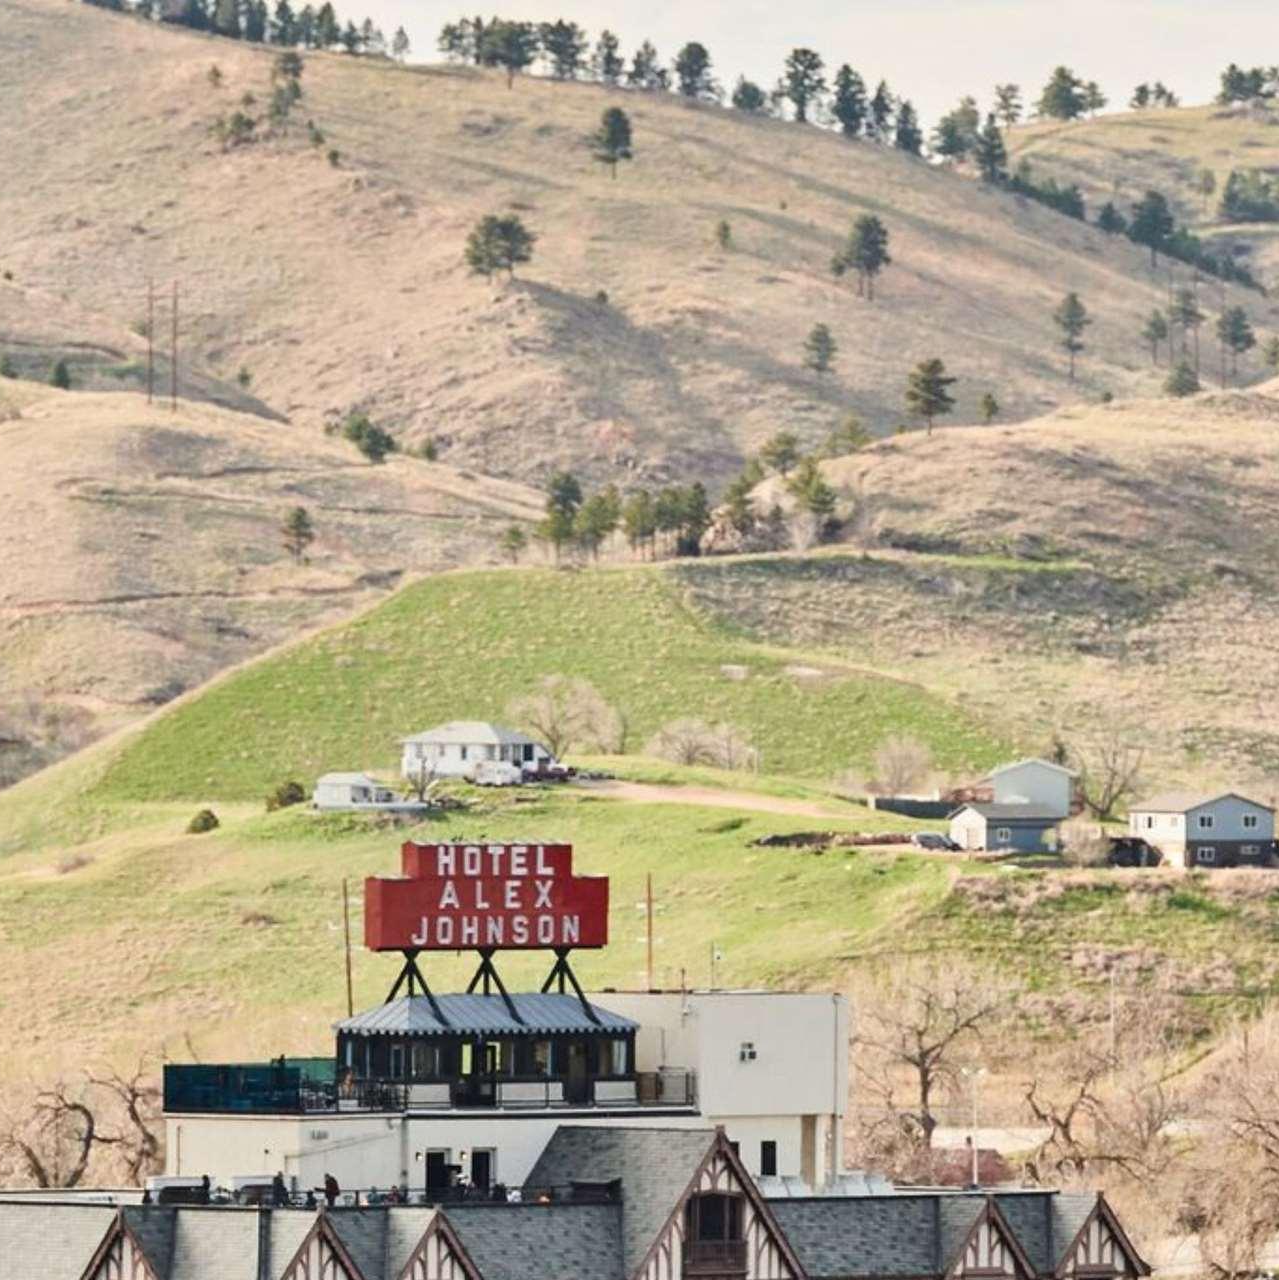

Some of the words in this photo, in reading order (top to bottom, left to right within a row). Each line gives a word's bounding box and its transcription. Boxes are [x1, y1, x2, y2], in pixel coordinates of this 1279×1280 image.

[437, 846, 555, 876] HOTEL
[438, 880, 553, 909] ALEX
[411, 915, 580, 945] JOHNSON
